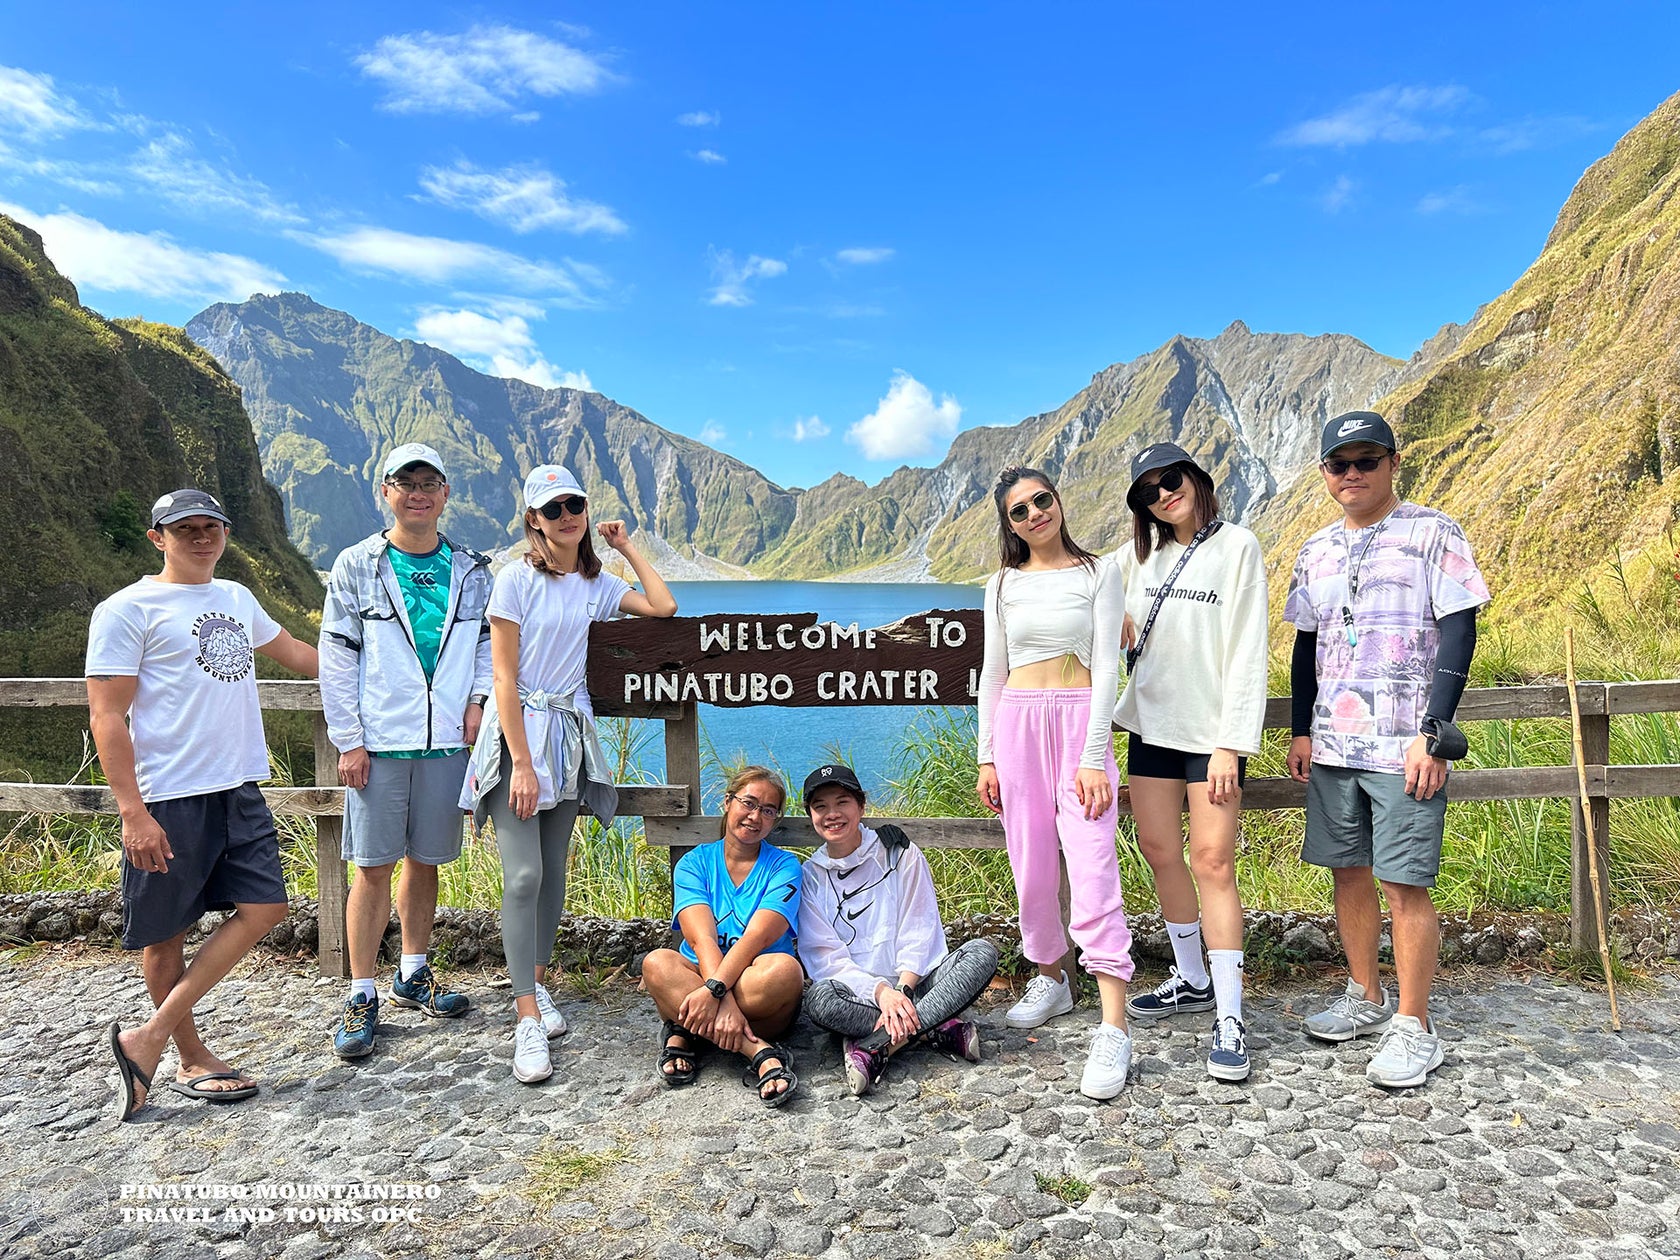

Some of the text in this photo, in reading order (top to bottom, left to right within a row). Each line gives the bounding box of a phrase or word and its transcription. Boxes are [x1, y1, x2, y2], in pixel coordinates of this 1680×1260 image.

[191, 612, 245, 637] PINATUBO
[699, 616, 967, 652] WELCOME TO
[624, 671, 794, 703] PINATUBO
[817, 668, 938, 700] CRATER
